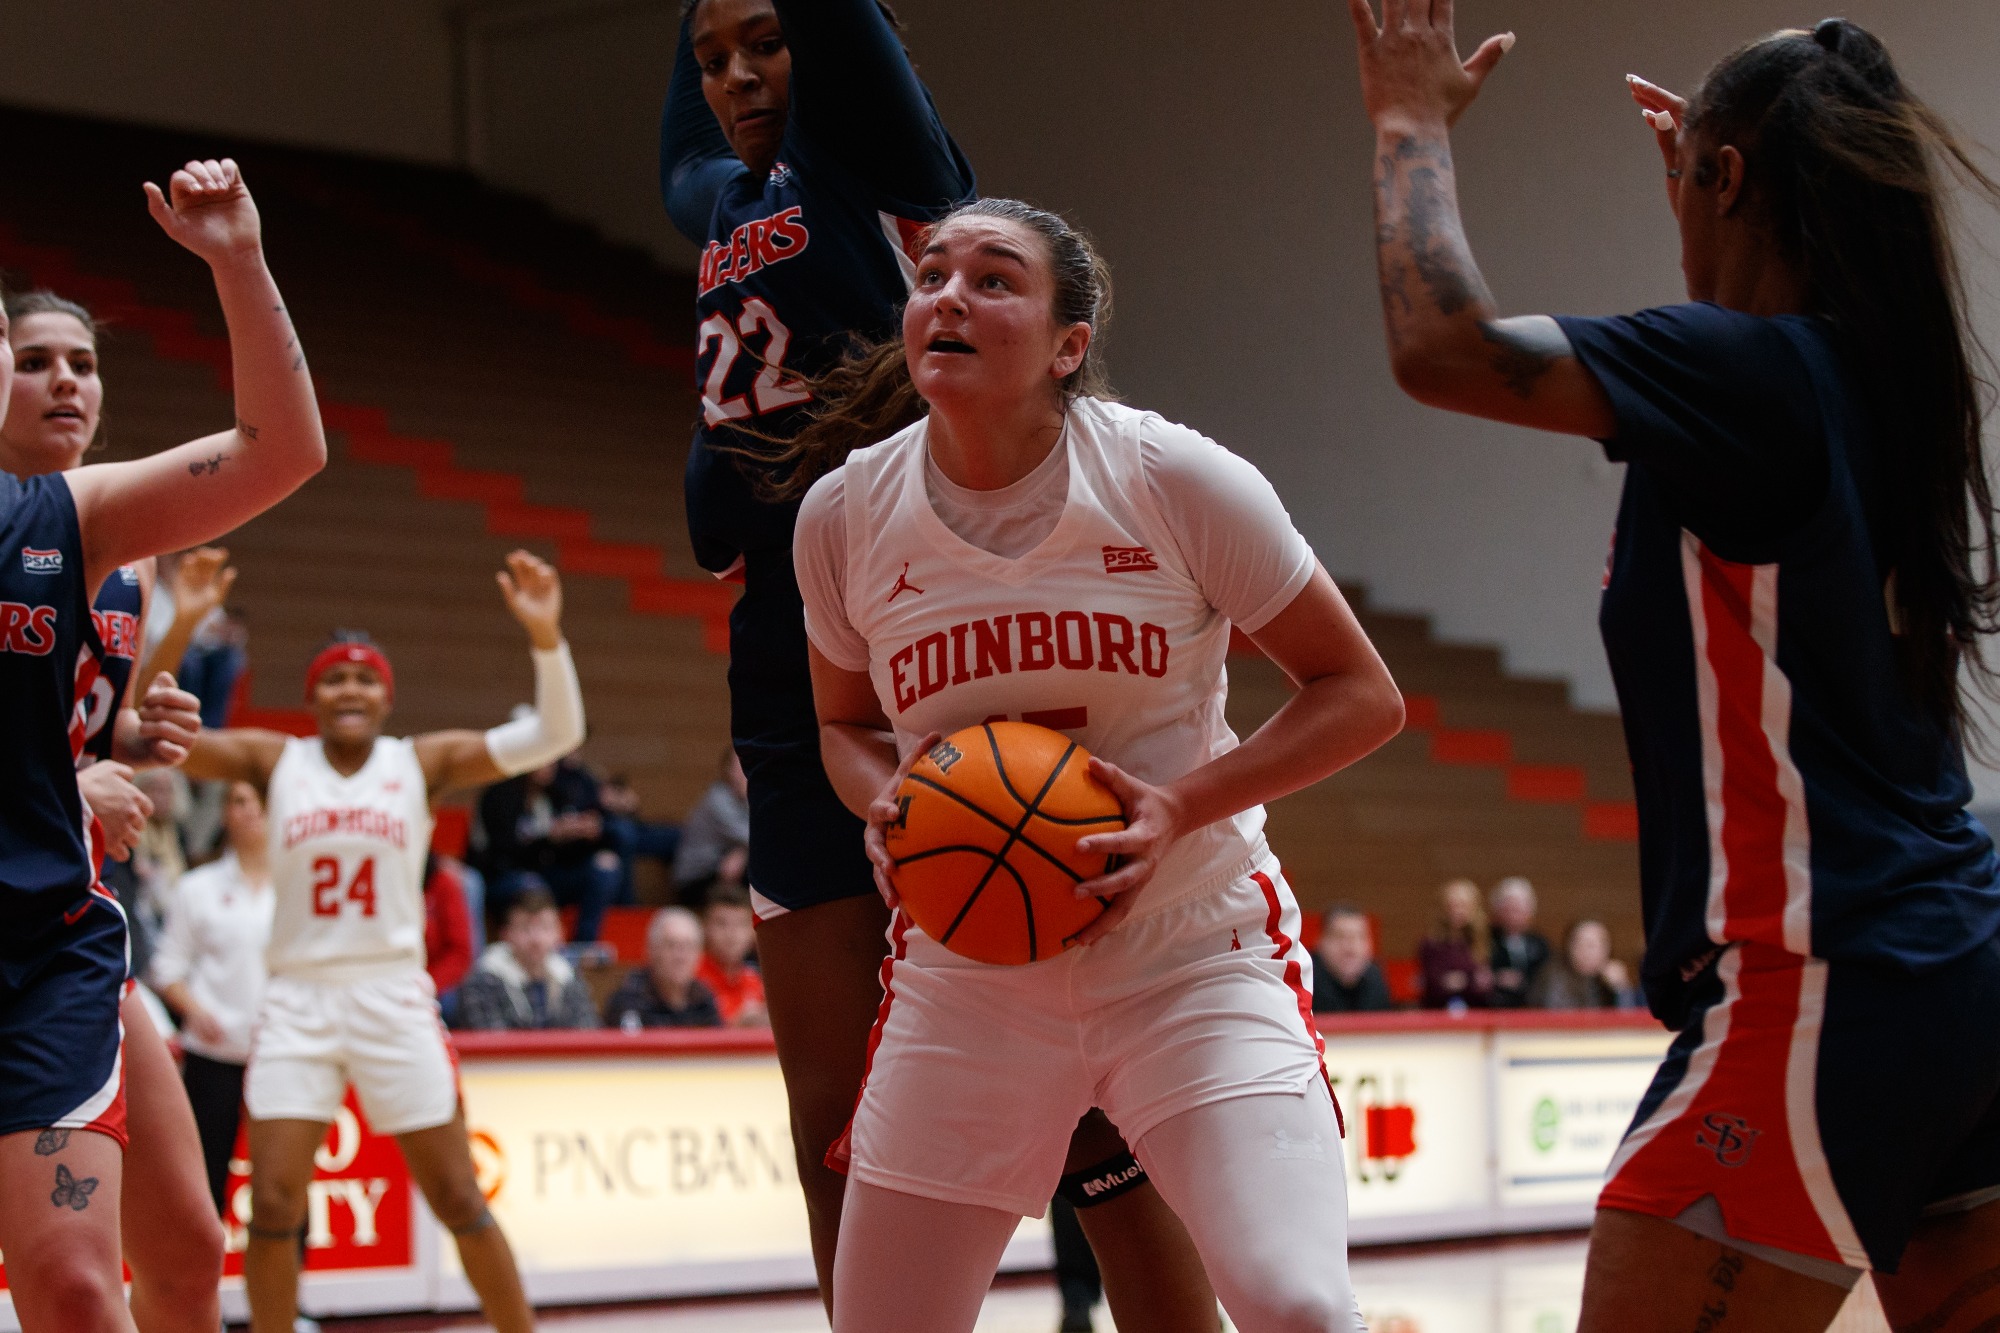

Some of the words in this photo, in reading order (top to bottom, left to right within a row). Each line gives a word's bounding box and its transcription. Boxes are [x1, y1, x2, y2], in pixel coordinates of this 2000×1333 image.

[699, 297, 813, 430] 22
[24, 554, 63, 568] PSAC
[1103, 550, 1159, 569] PSAC
[889, 611, 1169, 714] EDINBORO
[311, 856, 377, 919] 24
[532, 1126, 657, 1199] PNC
